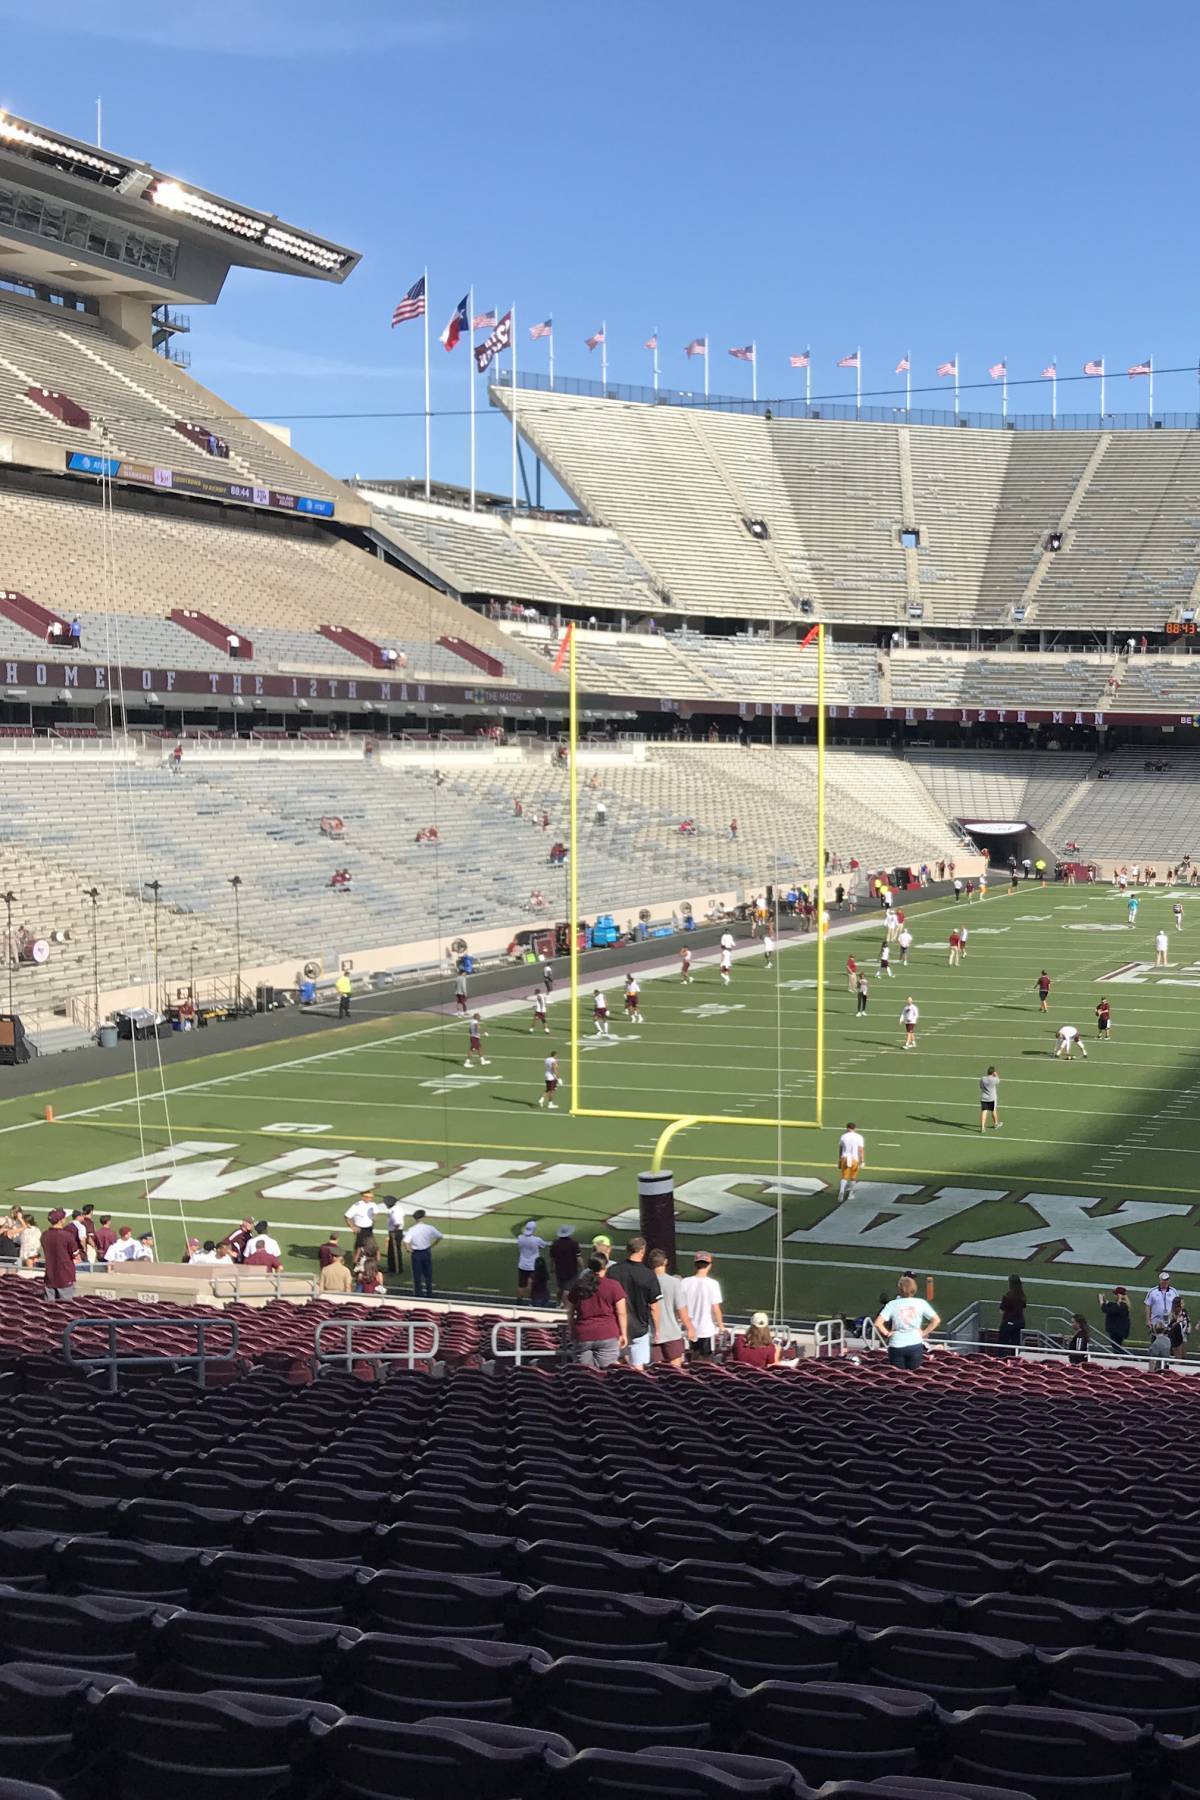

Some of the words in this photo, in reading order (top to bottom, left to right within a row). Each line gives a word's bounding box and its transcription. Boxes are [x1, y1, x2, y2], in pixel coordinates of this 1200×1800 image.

[6, 662, 105, 688] HOME
[142, 670, 176, 691] OF
[209, 673, 264, 694] THE
[292, 678, 357, 698] 12TH
[381, 682, 426, 701] MAN
[739, 702, 803, 717] HOME
[829, 705, 856, 718] OF
[884, 707, 934, 720] THE
[961, 708, 1026, 723] 12TH
[1052, 711, 1105, 725] MAN
[1180, 716, 1192, 724] BE
